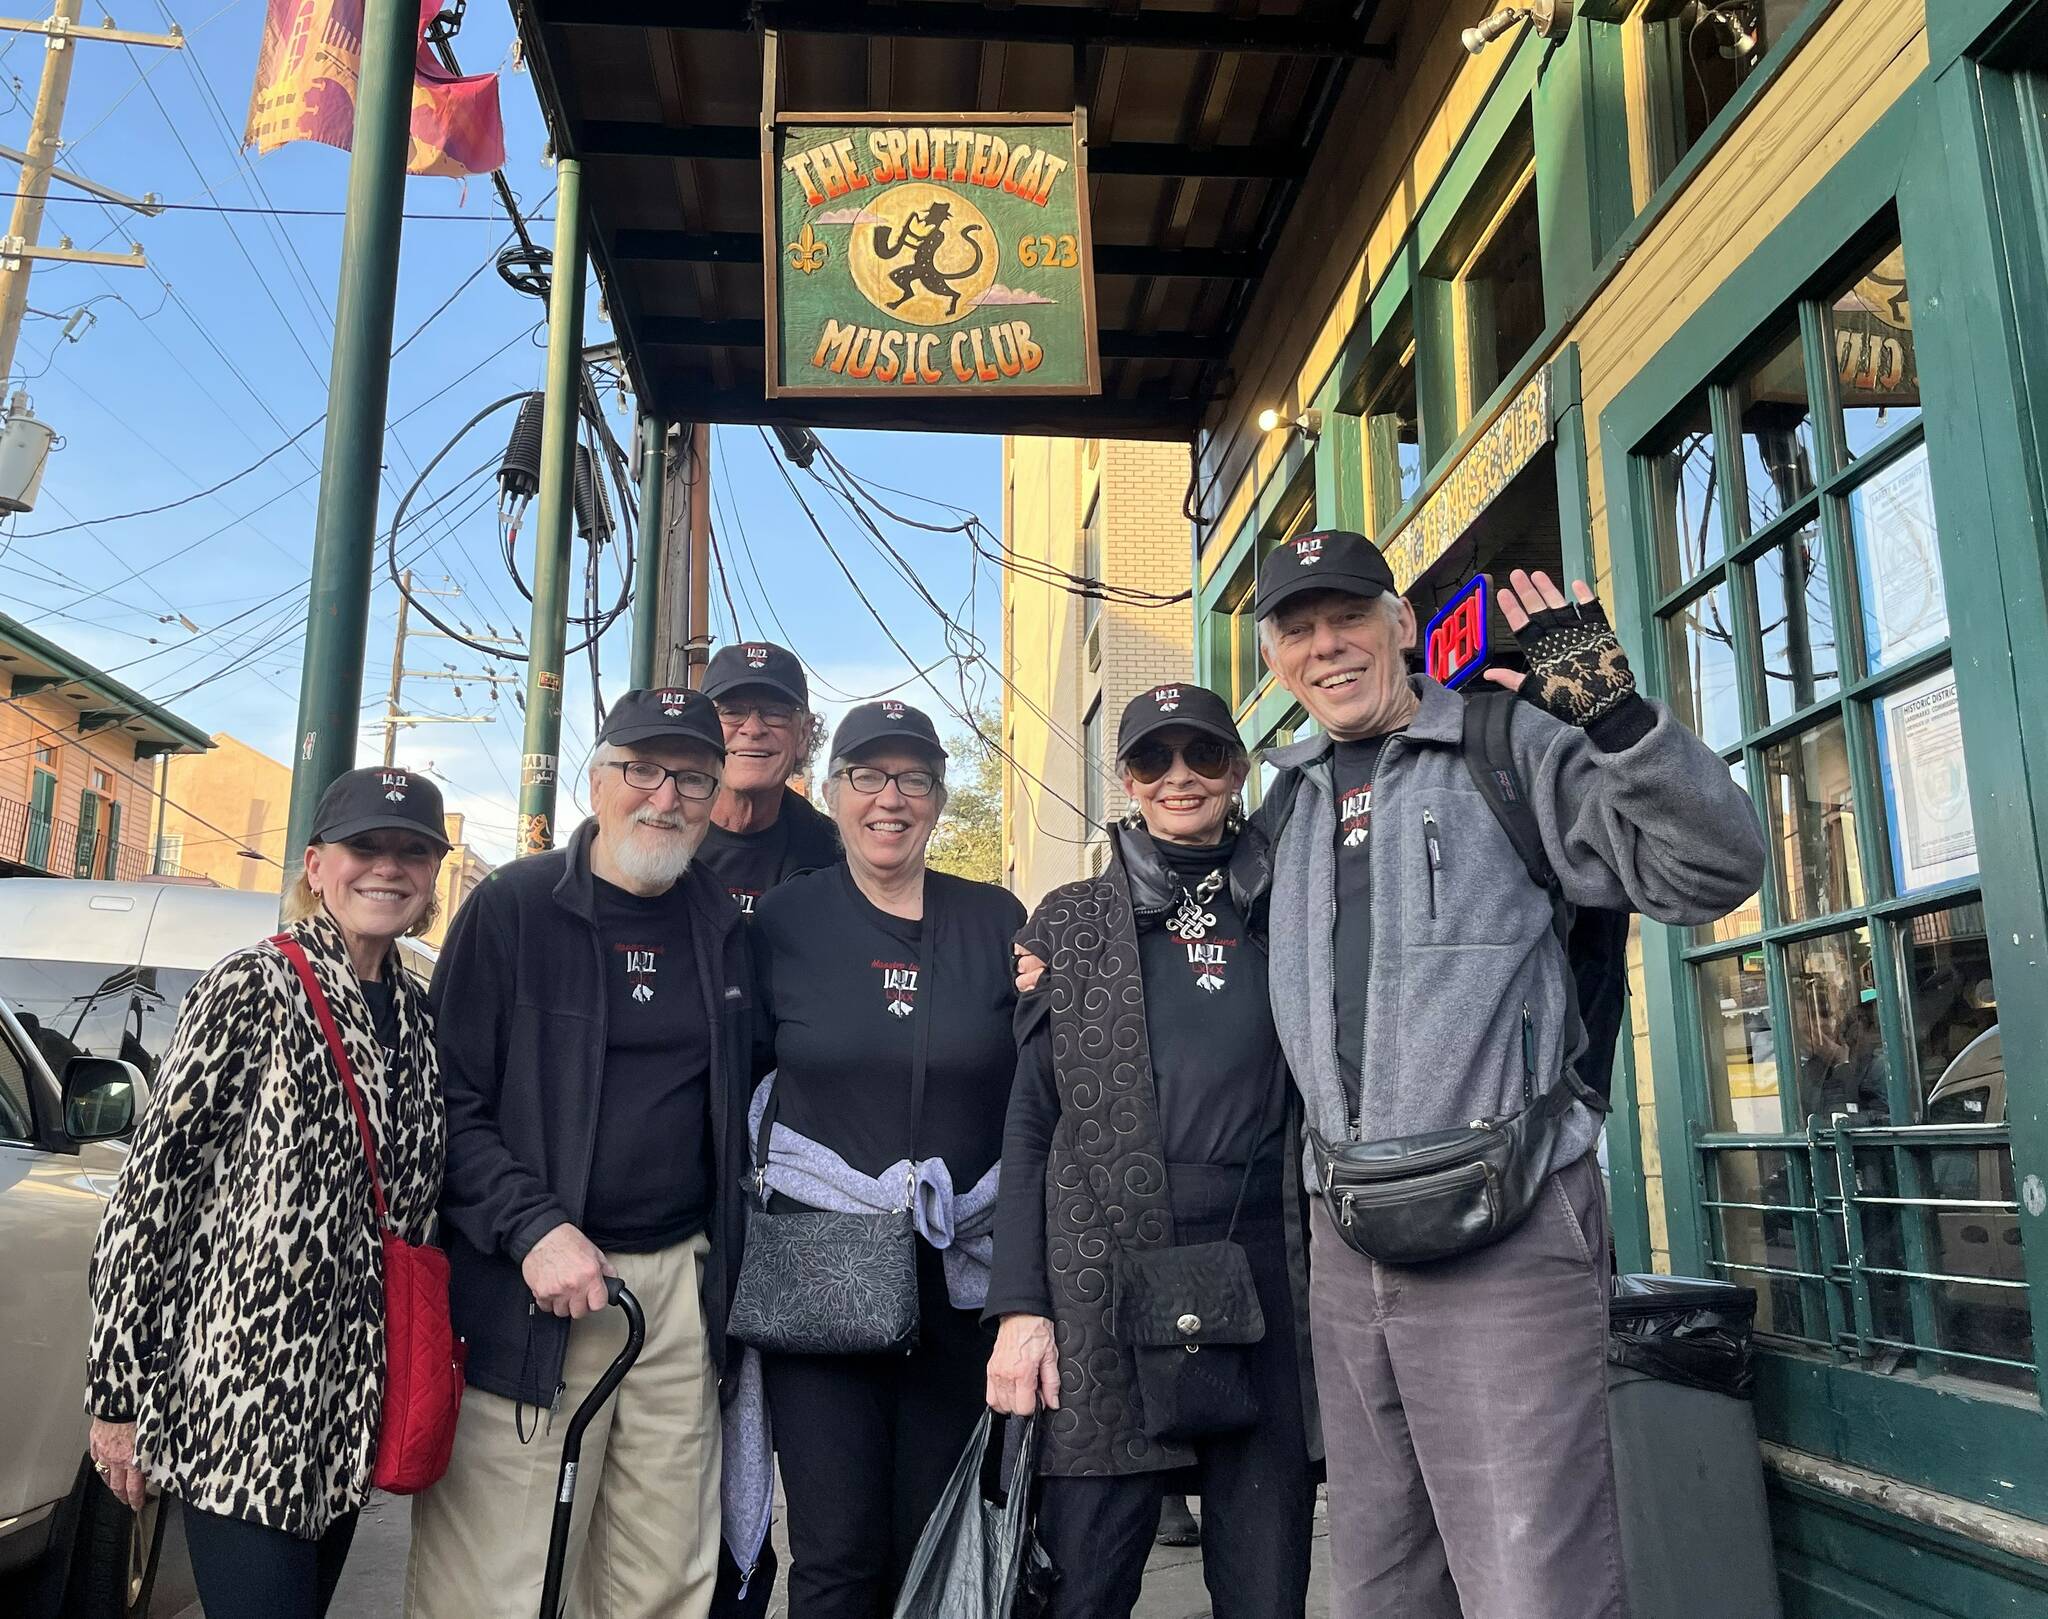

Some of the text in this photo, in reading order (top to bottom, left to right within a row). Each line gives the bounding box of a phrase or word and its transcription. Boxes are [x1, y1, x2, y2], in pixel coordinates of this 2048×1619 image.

[783, 137, 869, 207] THE
[1018, 234, 1079, 268] 623
[812, 318, 1045, 385] MUSIC CLUB
[1411, 488, 1442, 575] CAT
[1446, 436, 1499, 538] MUSIC
[1500, 380, 1542, 476] CLUB
[1429, 587, 1483, 684] OPEN
[1904, 686, 1956, 715] HISTORIC DISTRIC
[1340, 791, 1372, 822] JAZZ
[626, 951, 657, 973] JAZZ
[1186, 943, 1227, 964] JAZZ
[883, 968, 918, 991] JAZZ
